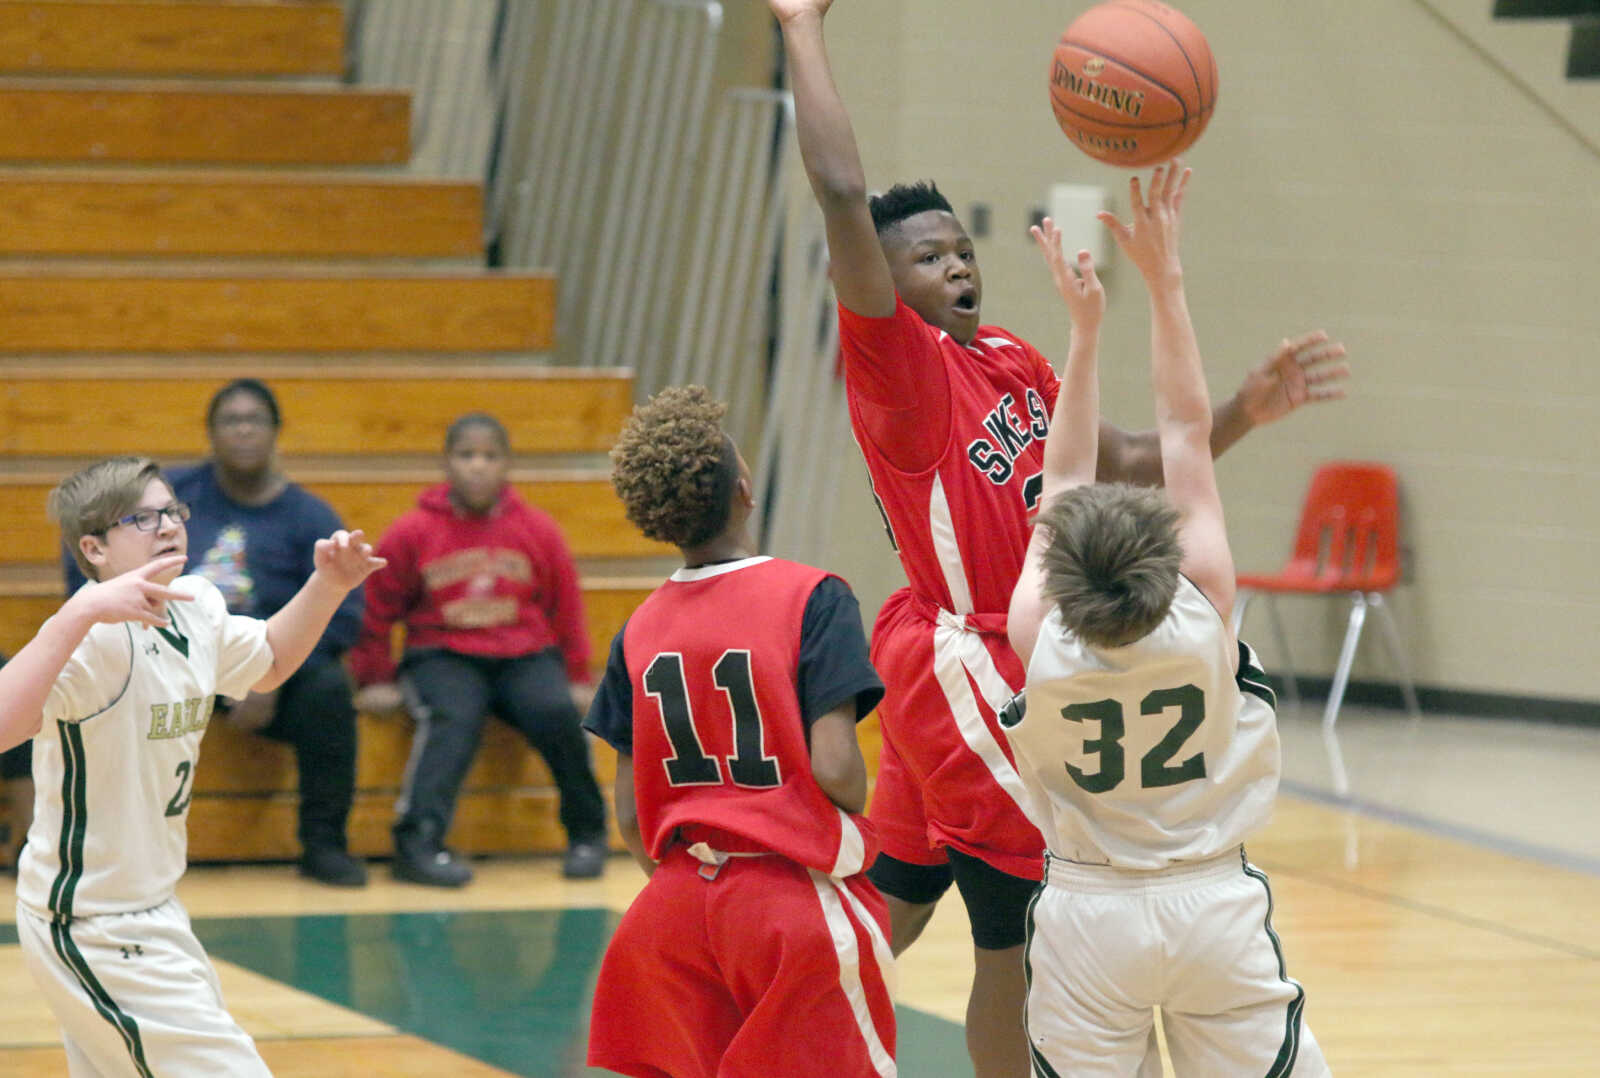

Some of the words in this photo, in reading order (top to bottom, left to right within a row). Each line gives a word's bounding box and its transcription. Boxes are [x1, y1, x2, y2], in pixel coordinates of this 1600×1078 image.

[643, 648, 784, 790] 11
[1061, 684, 1207, 794] 32
[164, 759, 196, 818] 2
